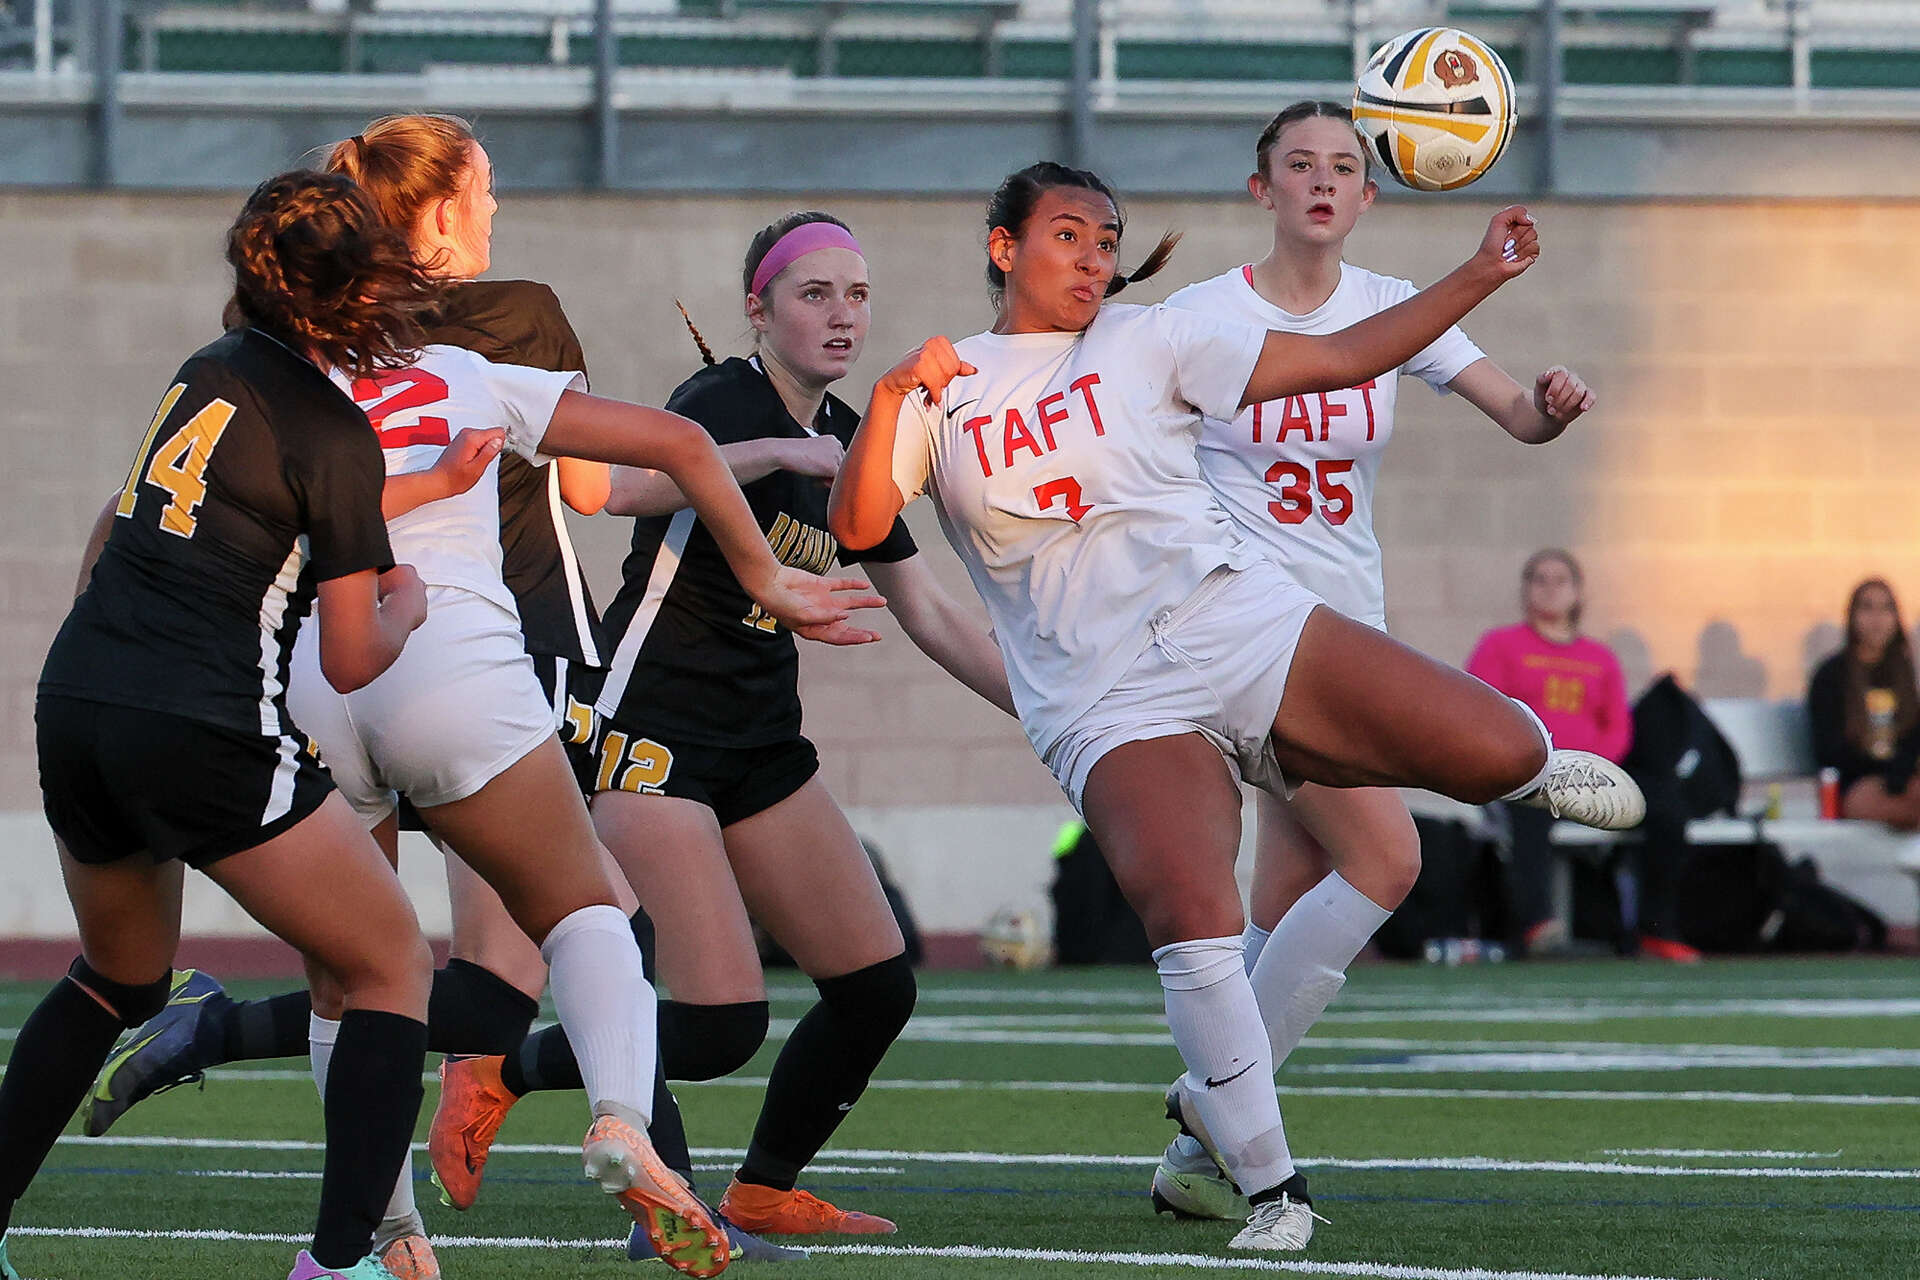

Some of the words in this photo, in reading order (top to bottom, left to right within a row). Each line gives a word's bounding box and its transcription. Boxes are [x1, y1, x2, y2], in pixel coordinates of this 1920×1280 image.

[115, 382, 237, 539] 14
[962, 372, 1106, 479] TAFT
[1264, 458, 1356, 526] 35
[594, 729, 674, 796] 12
